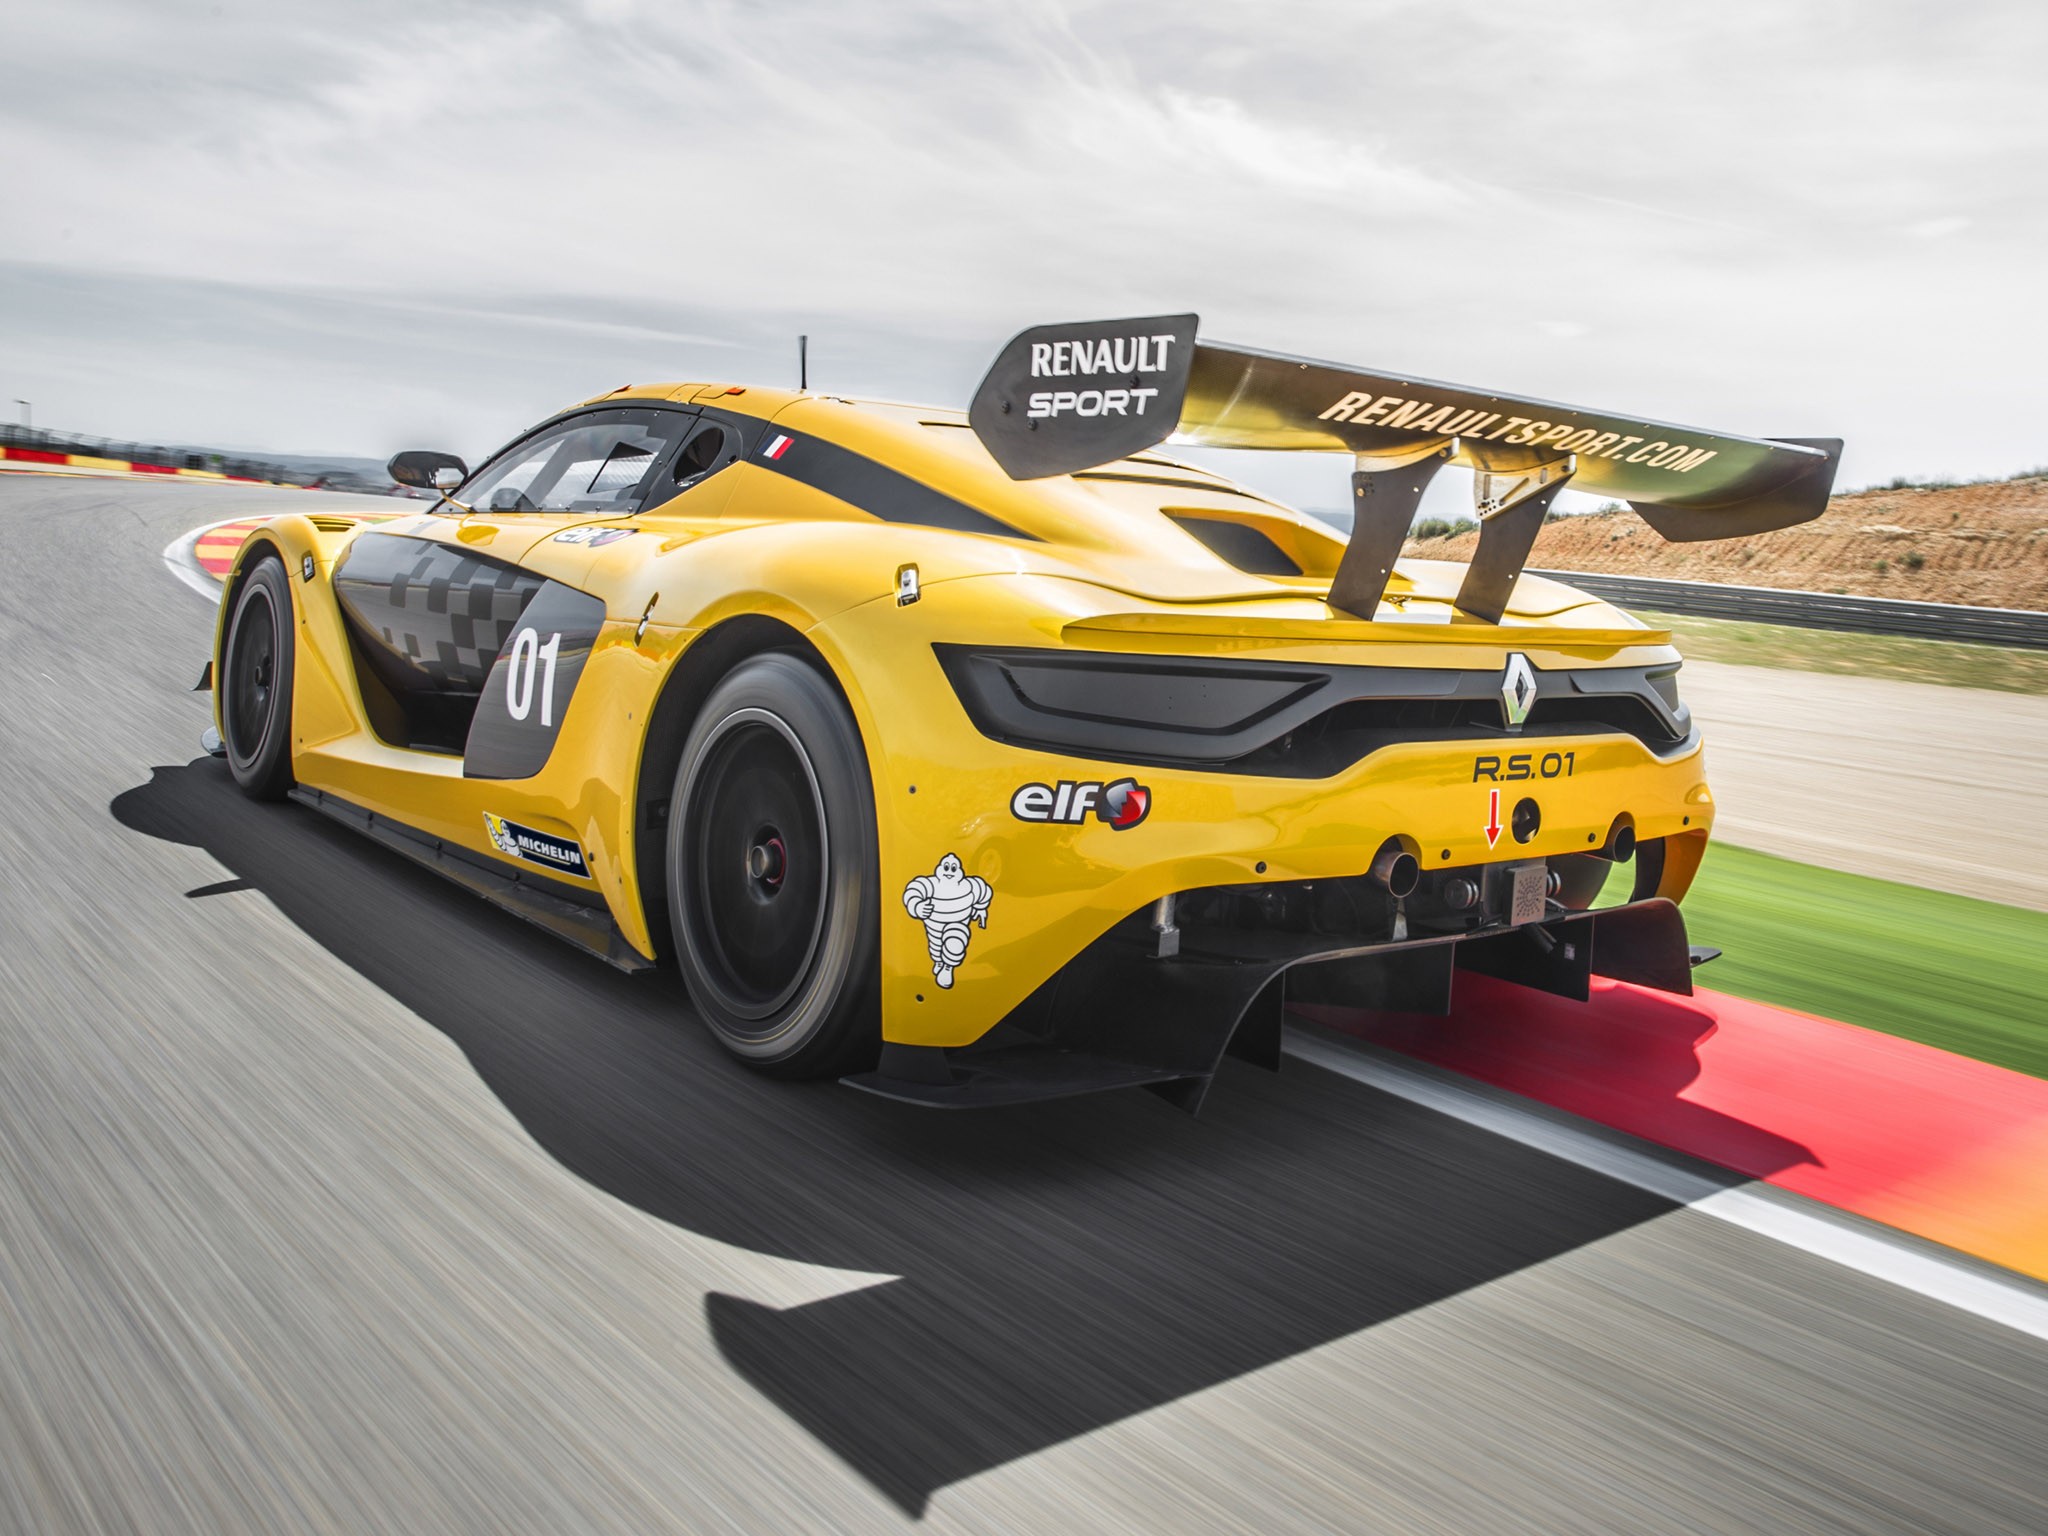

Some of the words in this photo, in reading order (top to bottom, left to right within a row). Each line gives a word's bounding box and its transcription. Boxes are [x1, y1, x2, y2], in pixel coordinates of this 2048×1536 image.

[1031, 334, 1175, 377] RENAULT
[1027, 387, 1158, 418] SPORT
[1317, 391, 1718, 473] RENAULTSPORT.COM
[506, 627, 561, 727] 01
[1472, 752, 1575, 783] R.S.01
[1013, 784, 1100, 821] elf
[517, 834, 581, 865] MICHELIN
